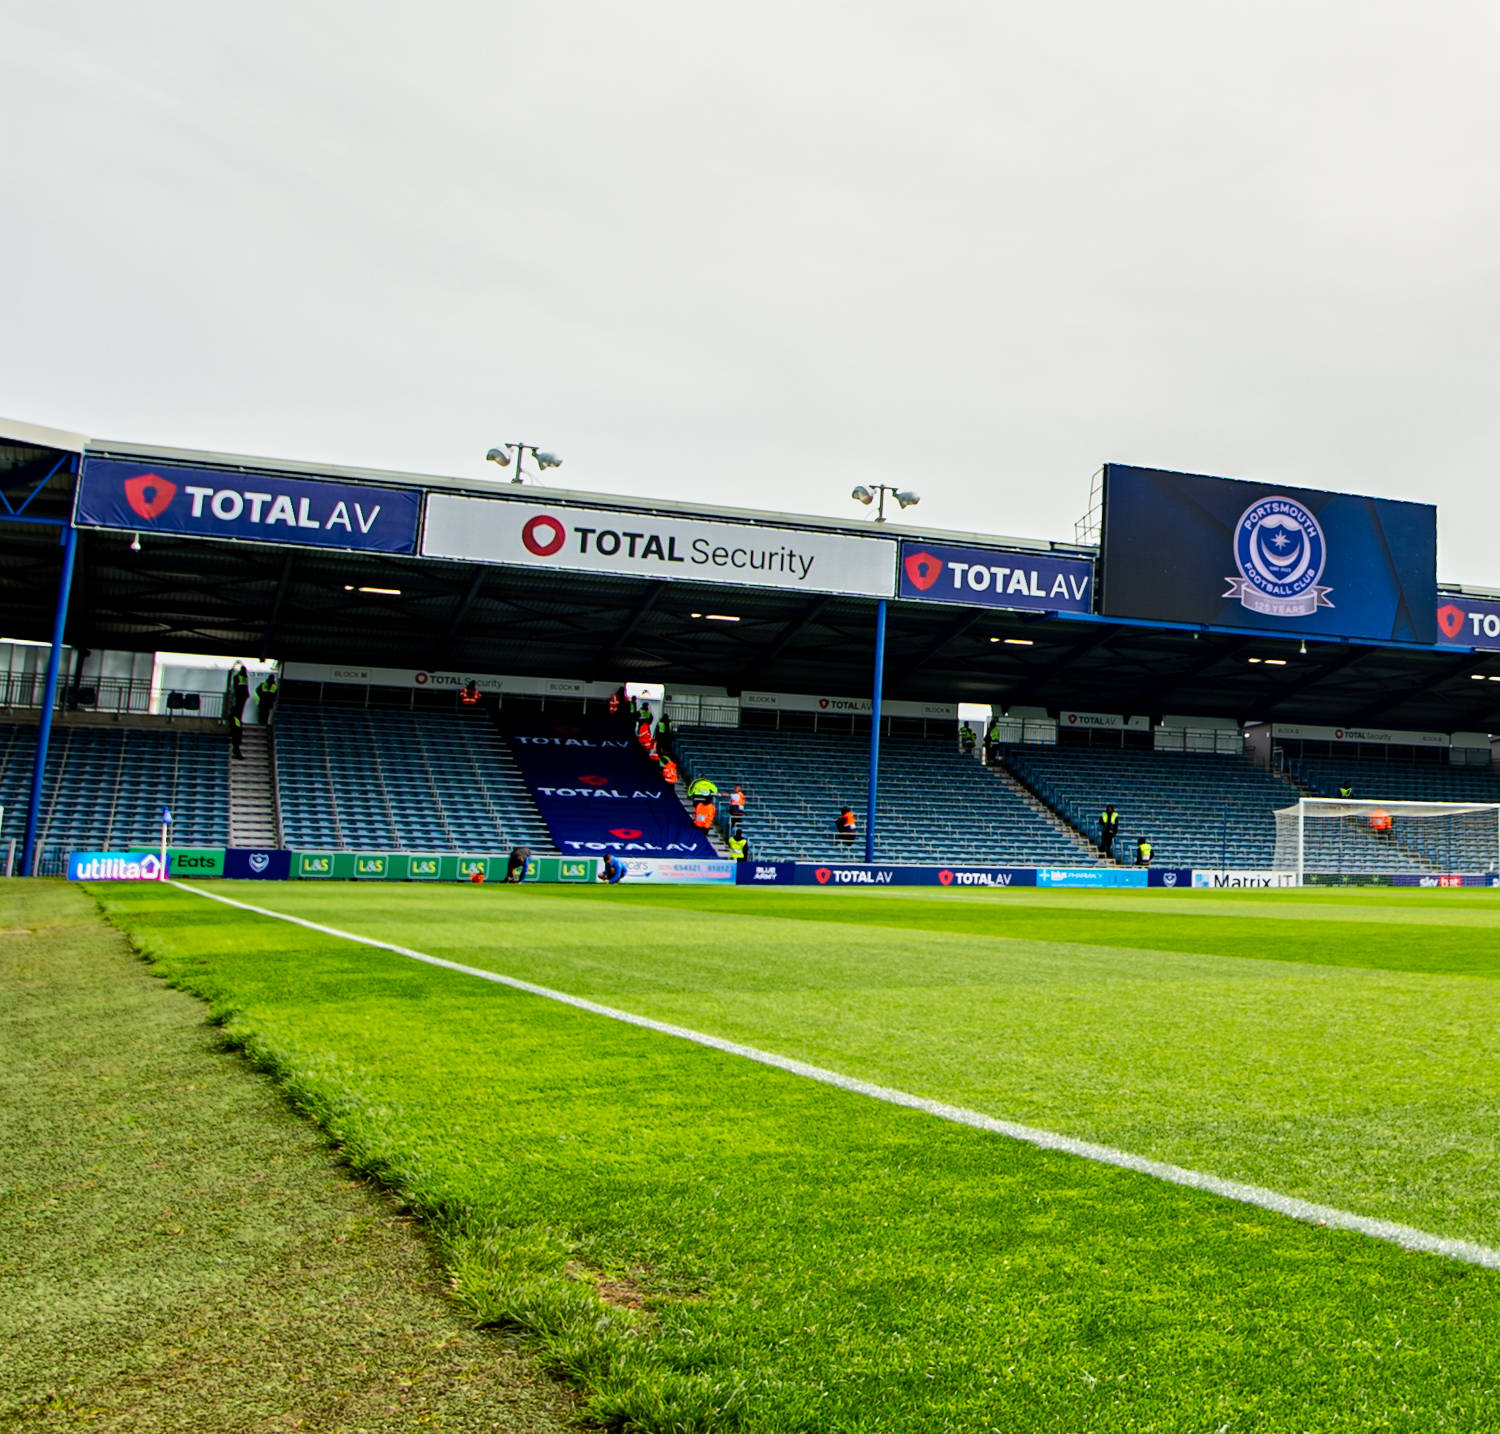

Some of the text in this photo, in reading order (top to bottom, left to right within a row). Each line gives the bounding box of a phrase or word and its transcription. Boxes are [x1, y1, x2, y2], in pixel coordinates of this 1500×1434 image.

[184, 485, 381, 534] TOTAL AV
[1244, 502, 1317, 537] PORTSMOUTH
[573, 526, 814, 581] TOTAL Security
[948, 562, 1089, 600] TOTAL AV
[1244, 562, 1315, 594] FOOTBALL CLUB
[334, 671, 359, 679] BLOCK
[430, 675, 504, 690] TOTAL Scurity
[748, 695, 770, 703] BLOCK
[830, 700, 859, 710] TOTAL
[1079, 715, 1104, 725] TOTAL
[1344, 731, 1365, 739] TOTAL
[514, 736, 630, 748] TOTAL AV
[537, 787, 662, 799] TOTAL AV
[564, 840, 698, 851] TOTAL AV
[178, 855, 216, 868] Eats
[304, 858, 329, 872] L&S
[358, 860, 383, 873] L&S
[412, 861, 436, 874] L&S
[461, 862, 485, 874] L&S
[76, 858, 140, 879] utilita
[562, 863, 585, 876] L&S
[833, 870, 893, 883] TOTAL AV
[955, 872, 1012, 885] TOTAL AV
[1214, 874, 1293, 888] Matrix IT
